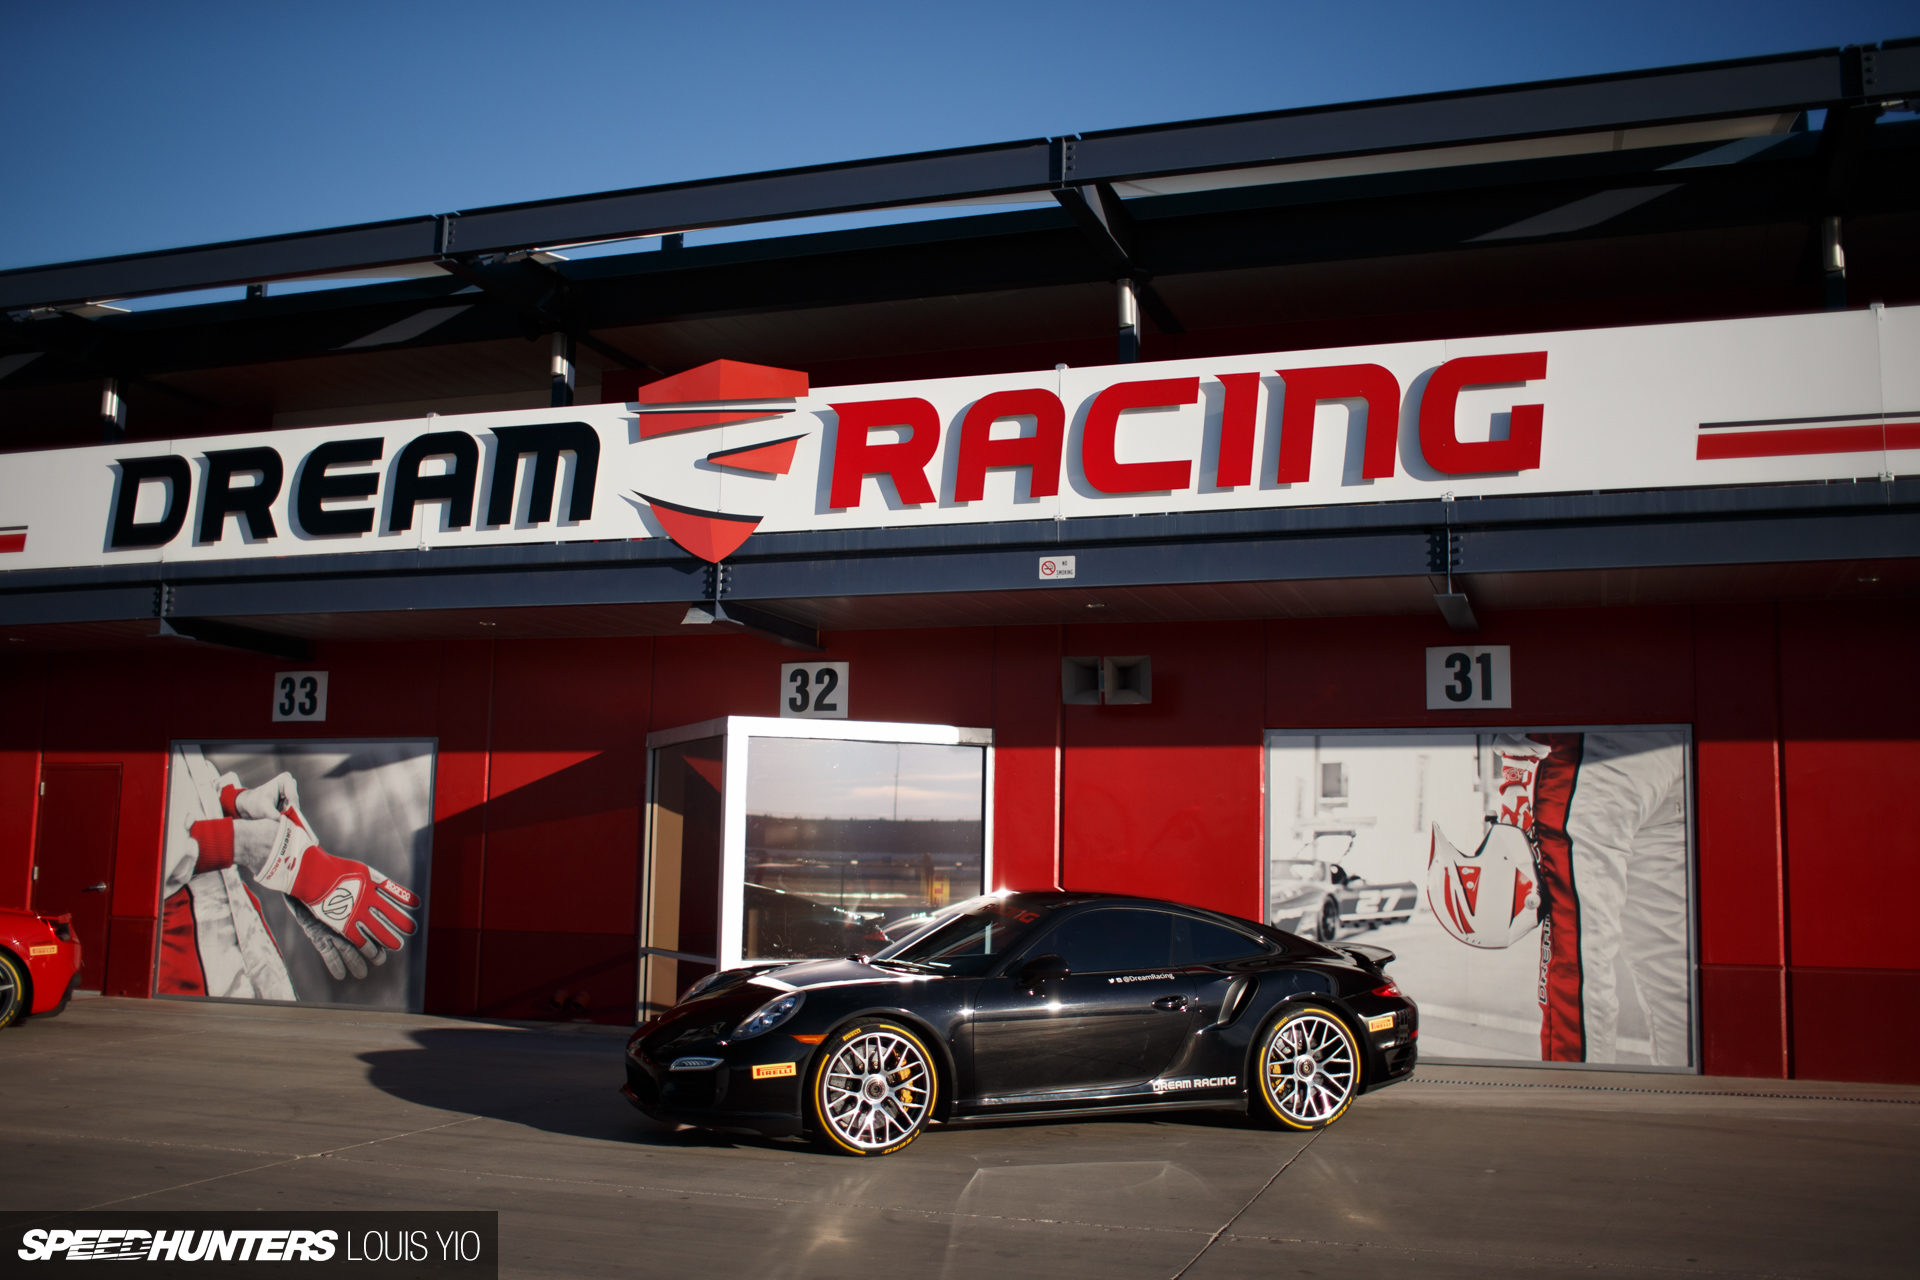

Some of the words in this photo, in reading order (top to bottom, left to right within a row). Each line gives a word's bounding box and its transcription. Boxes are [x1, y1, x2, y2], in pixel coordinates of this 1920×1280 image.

[111, 421, 601, 548] DREAM
[828, 350, 1548, 509] RACING
[788, 667, 839, 712] 32
[1445, 652, 1492, 702] 31
[279, 676, 318, 716] 33
[280, 827, 292, 856] DREAM
[266, 857, 282, 880] RACING
[1355, 888, 1403, 914] 27
[1122, 973, 1175, 983] @DreamRacing
[1370, 1019, 1391, 1030] PIRELLI
[756, 1065, 792, 1077] PIRELLI
[1152, 1079, 1192, 1092] DREAM
[1193, 1076, 1237, 1088] RACING
